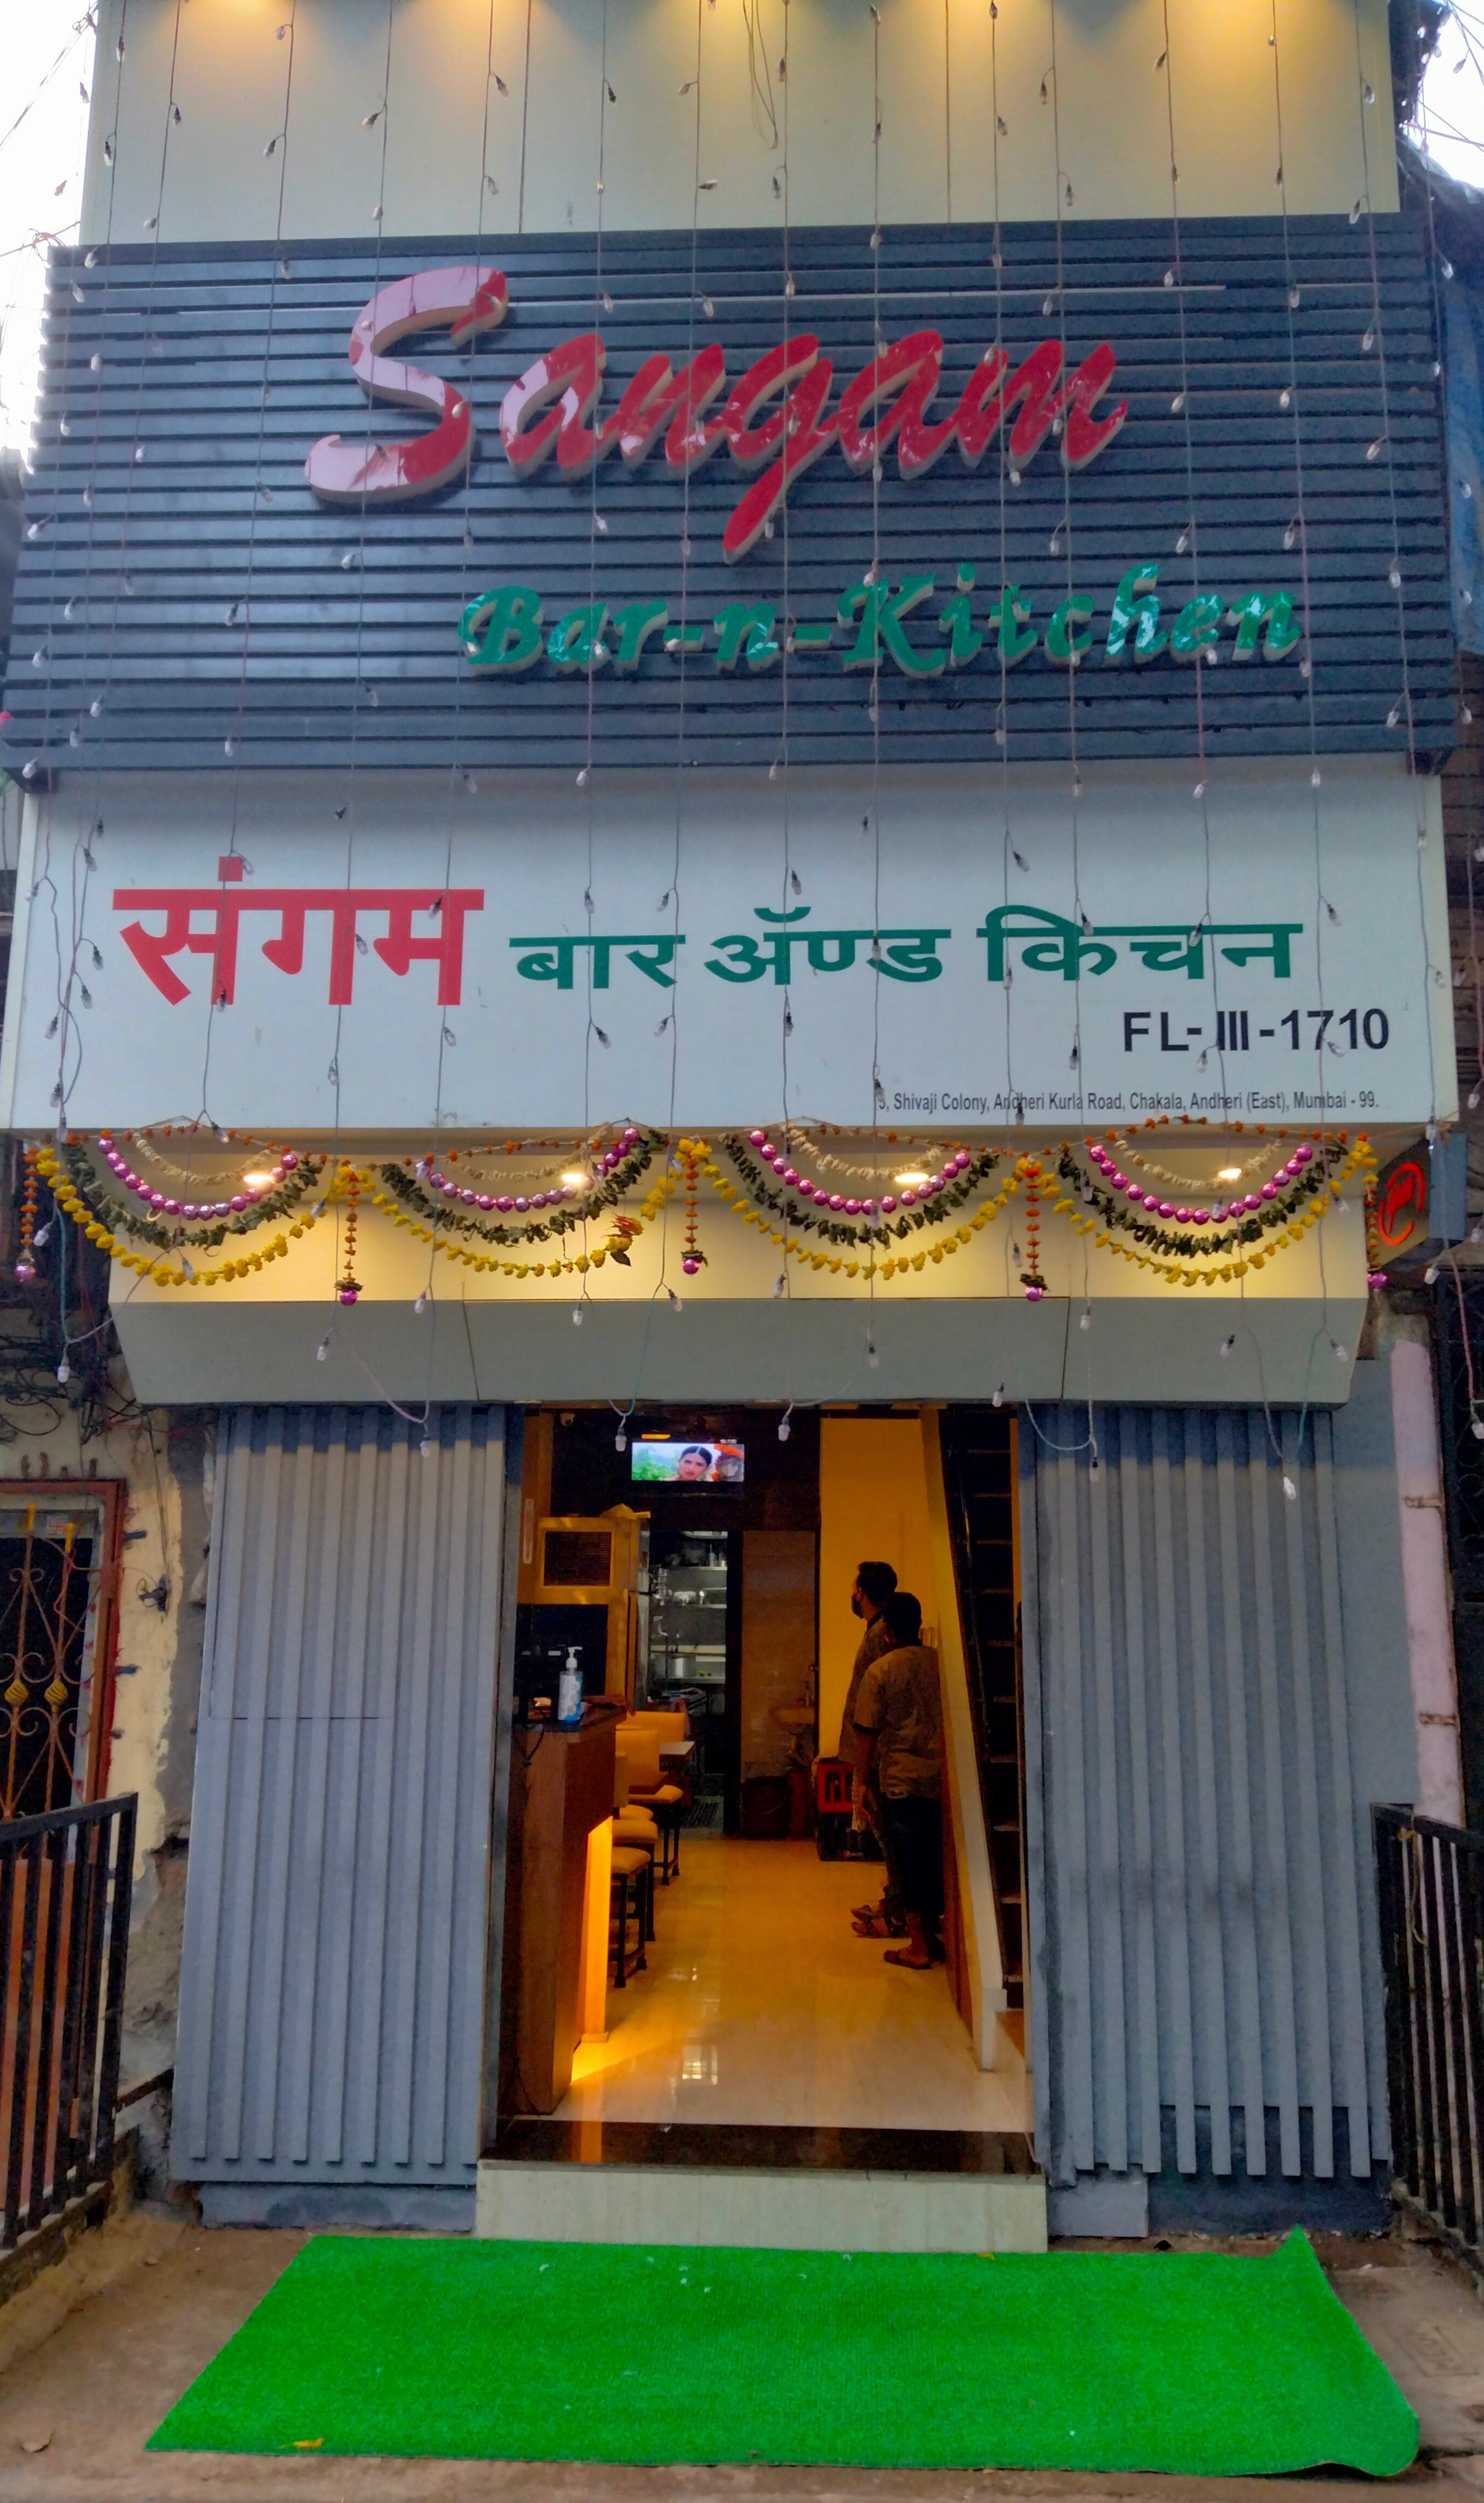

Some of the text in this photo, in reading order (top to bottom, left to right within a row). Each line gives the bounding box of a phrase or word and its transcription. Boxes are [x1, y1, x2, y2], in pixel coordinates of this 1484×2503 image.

[303, 265, 1128, 563] Sangam
[458, 563, 1305, 677] Bar-n-Kitchen
[112, 856, 485, 1006] संगम
[509, 933, 687, 990] बार
[976, 905, 1303, 981] किचन
[894, 1092, 937, 1114] Shivaji
[941, 1092, 990, 1114] Colony,
[993, 1092, 1044, 1110] Andheri
[1049, 1092, 1083, 1110] Kurla
[1087, 1092, 1126, 1112] Road,
[1129, 1092, 1187, 1112] Chakala,
[1190, 1091, 1242, 1109] Andheri
[1247, 1091, 1290, 1114] (East),
[1293, 1091, 1347, 1109] Mumbai
[1359, 1091, 1379, 1108] 99.
